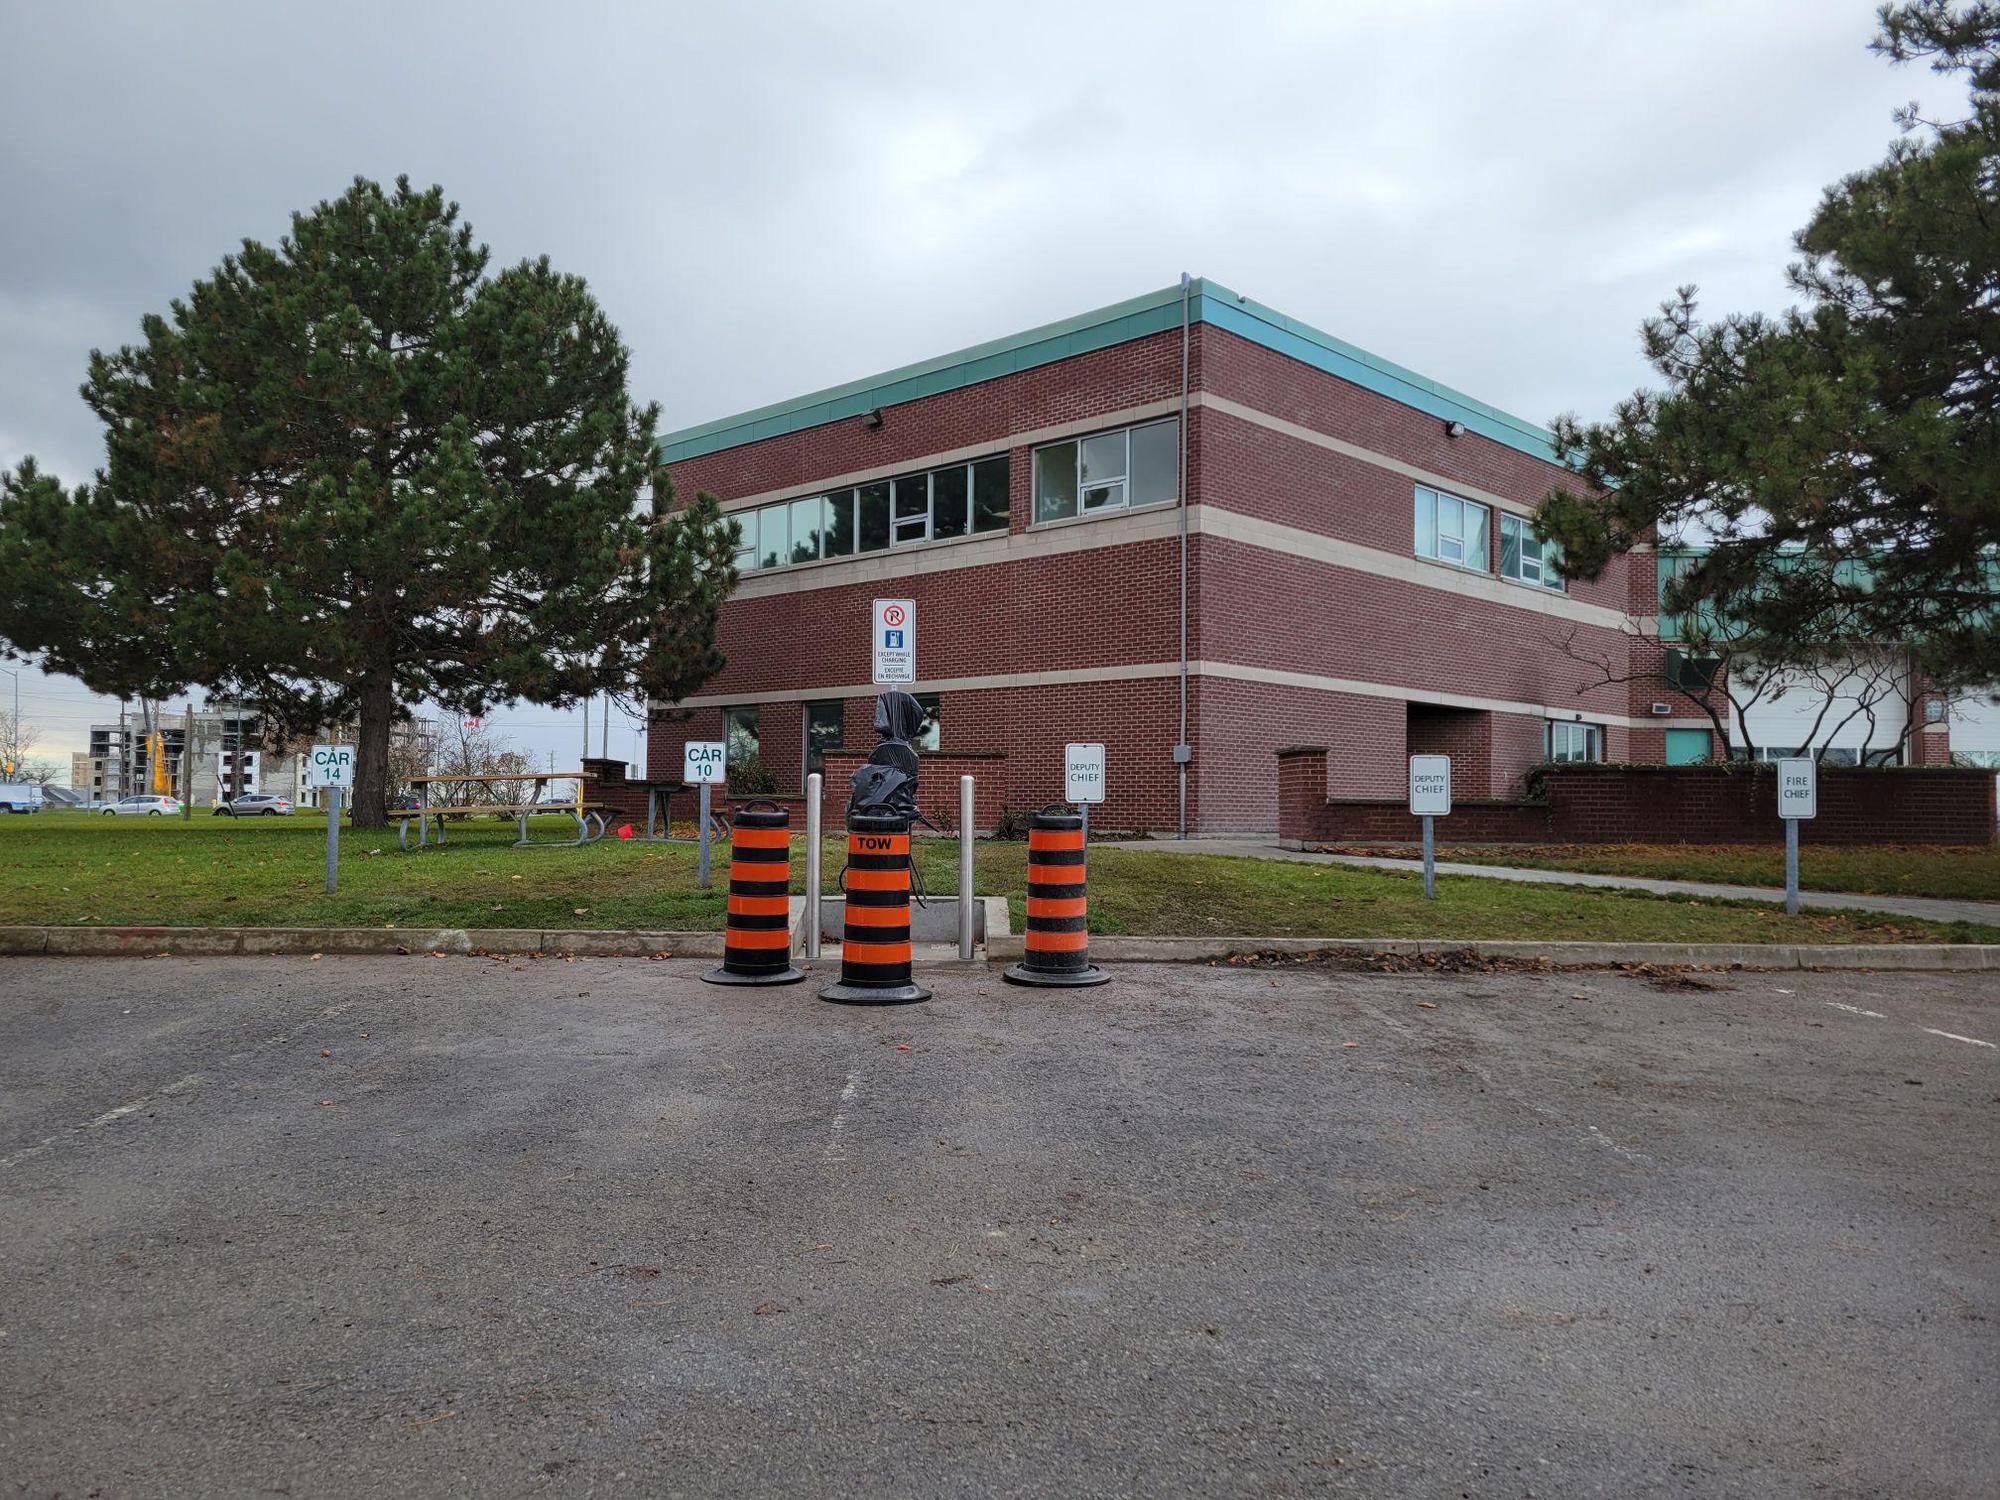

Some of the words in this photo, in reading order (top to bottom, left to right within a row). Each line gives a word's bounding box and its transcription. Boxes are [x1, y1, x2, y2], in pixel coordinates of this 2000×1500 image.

[315, 752, 350, 766] CAR
[688, 749, 722, 762] CAR
[695, 764, 712, 777] 10
[1070, 763, 1100, 771] DEPUTY
[323, 767, 341, 780] 14
[1070, 773, 1100, 782] CHIEF
[1414, 775, 1445, 783] DEPUTY
[1786, 776, 1808, 786] FIRE
[1414, 785, 1445, 794] CHIEF
[1783, 789, 1810, 799] CHIEF
[857, 837, 892, 850] TOW
